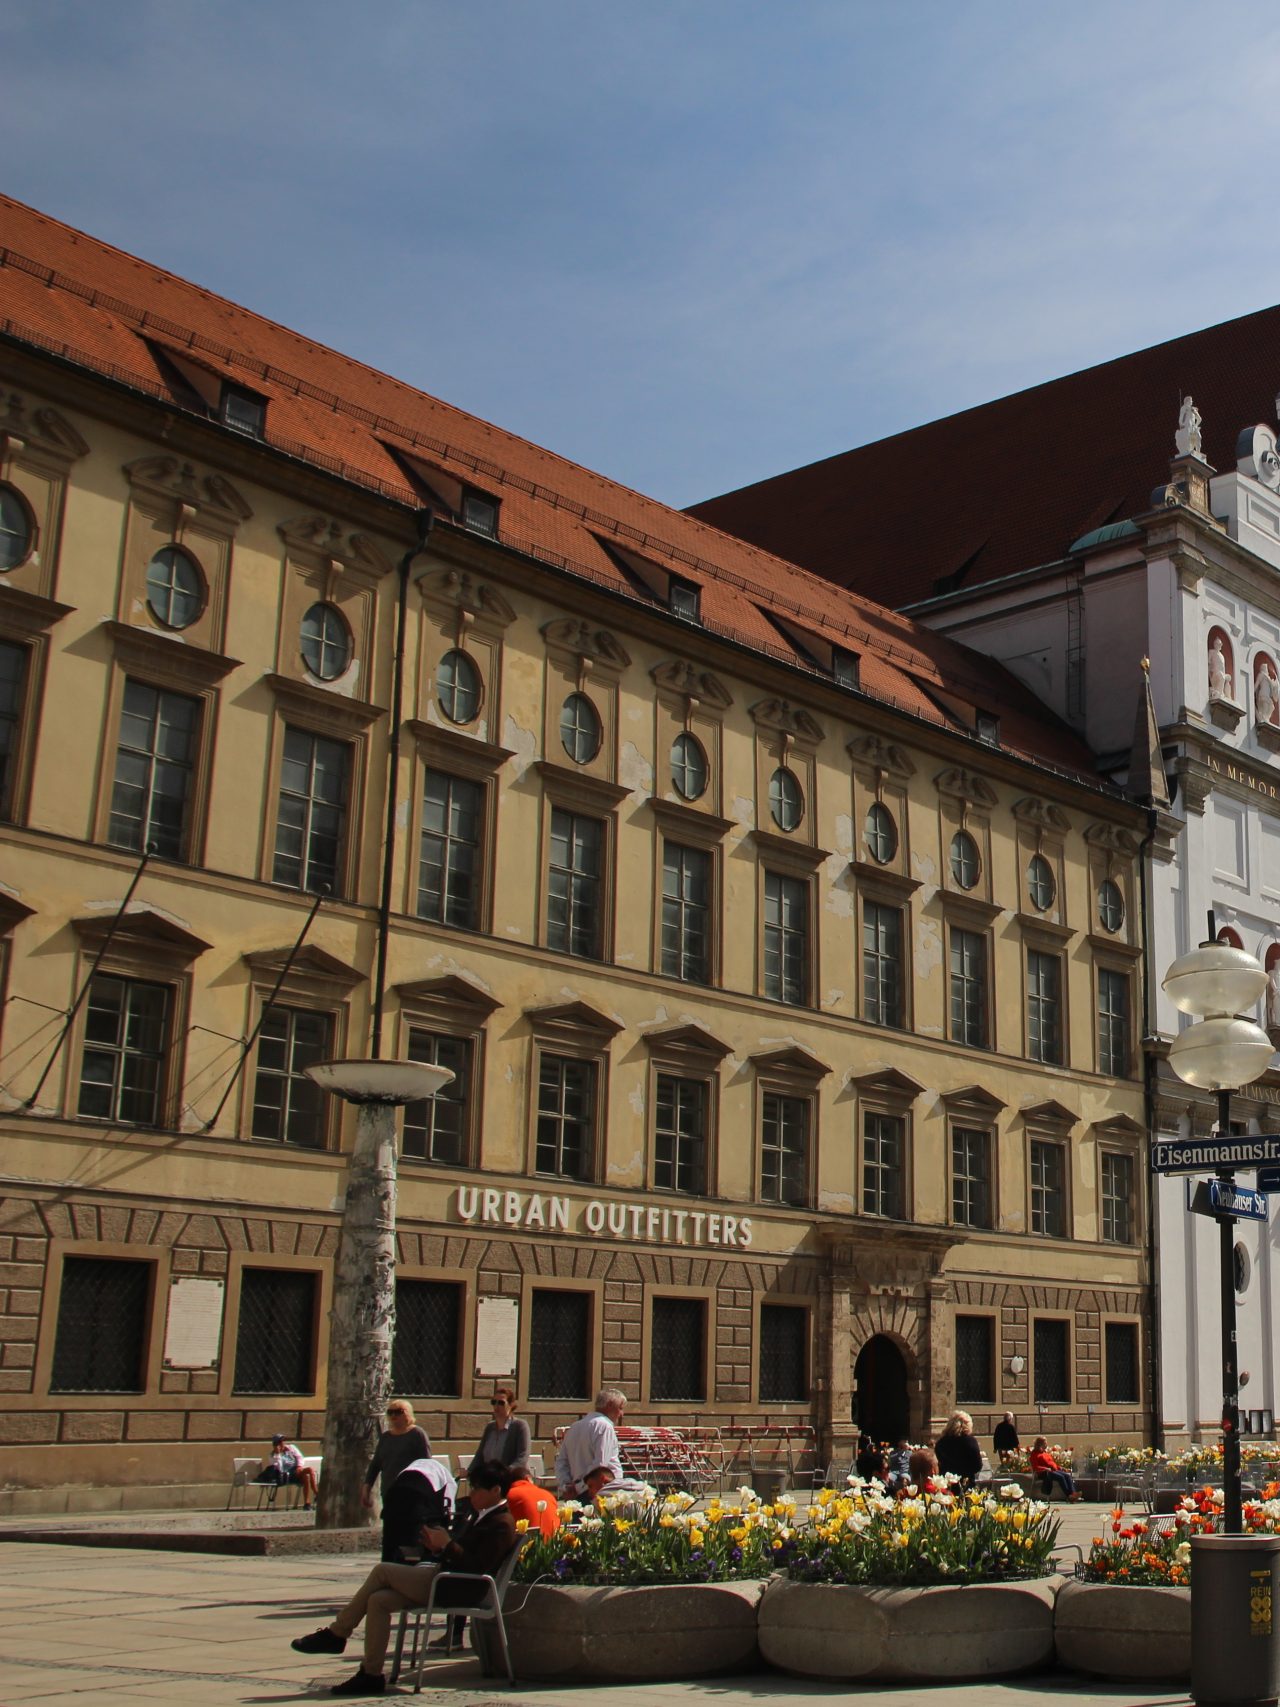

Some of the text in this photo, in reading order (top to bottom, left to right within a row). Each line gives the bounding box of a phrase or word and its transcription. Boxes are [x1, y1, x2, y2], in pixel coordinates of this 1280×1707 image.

[1207, 755, 1219, 773] IN
[1156, 1139, 1280, 1166] Eisenmannstr.
[1215, 1183, 1266, 1215] Neuhauser Str.
[457, 1185, 752, 1246] URBAN OUTFITTERS
[1250, 1586, 1271, 1597] REIN
